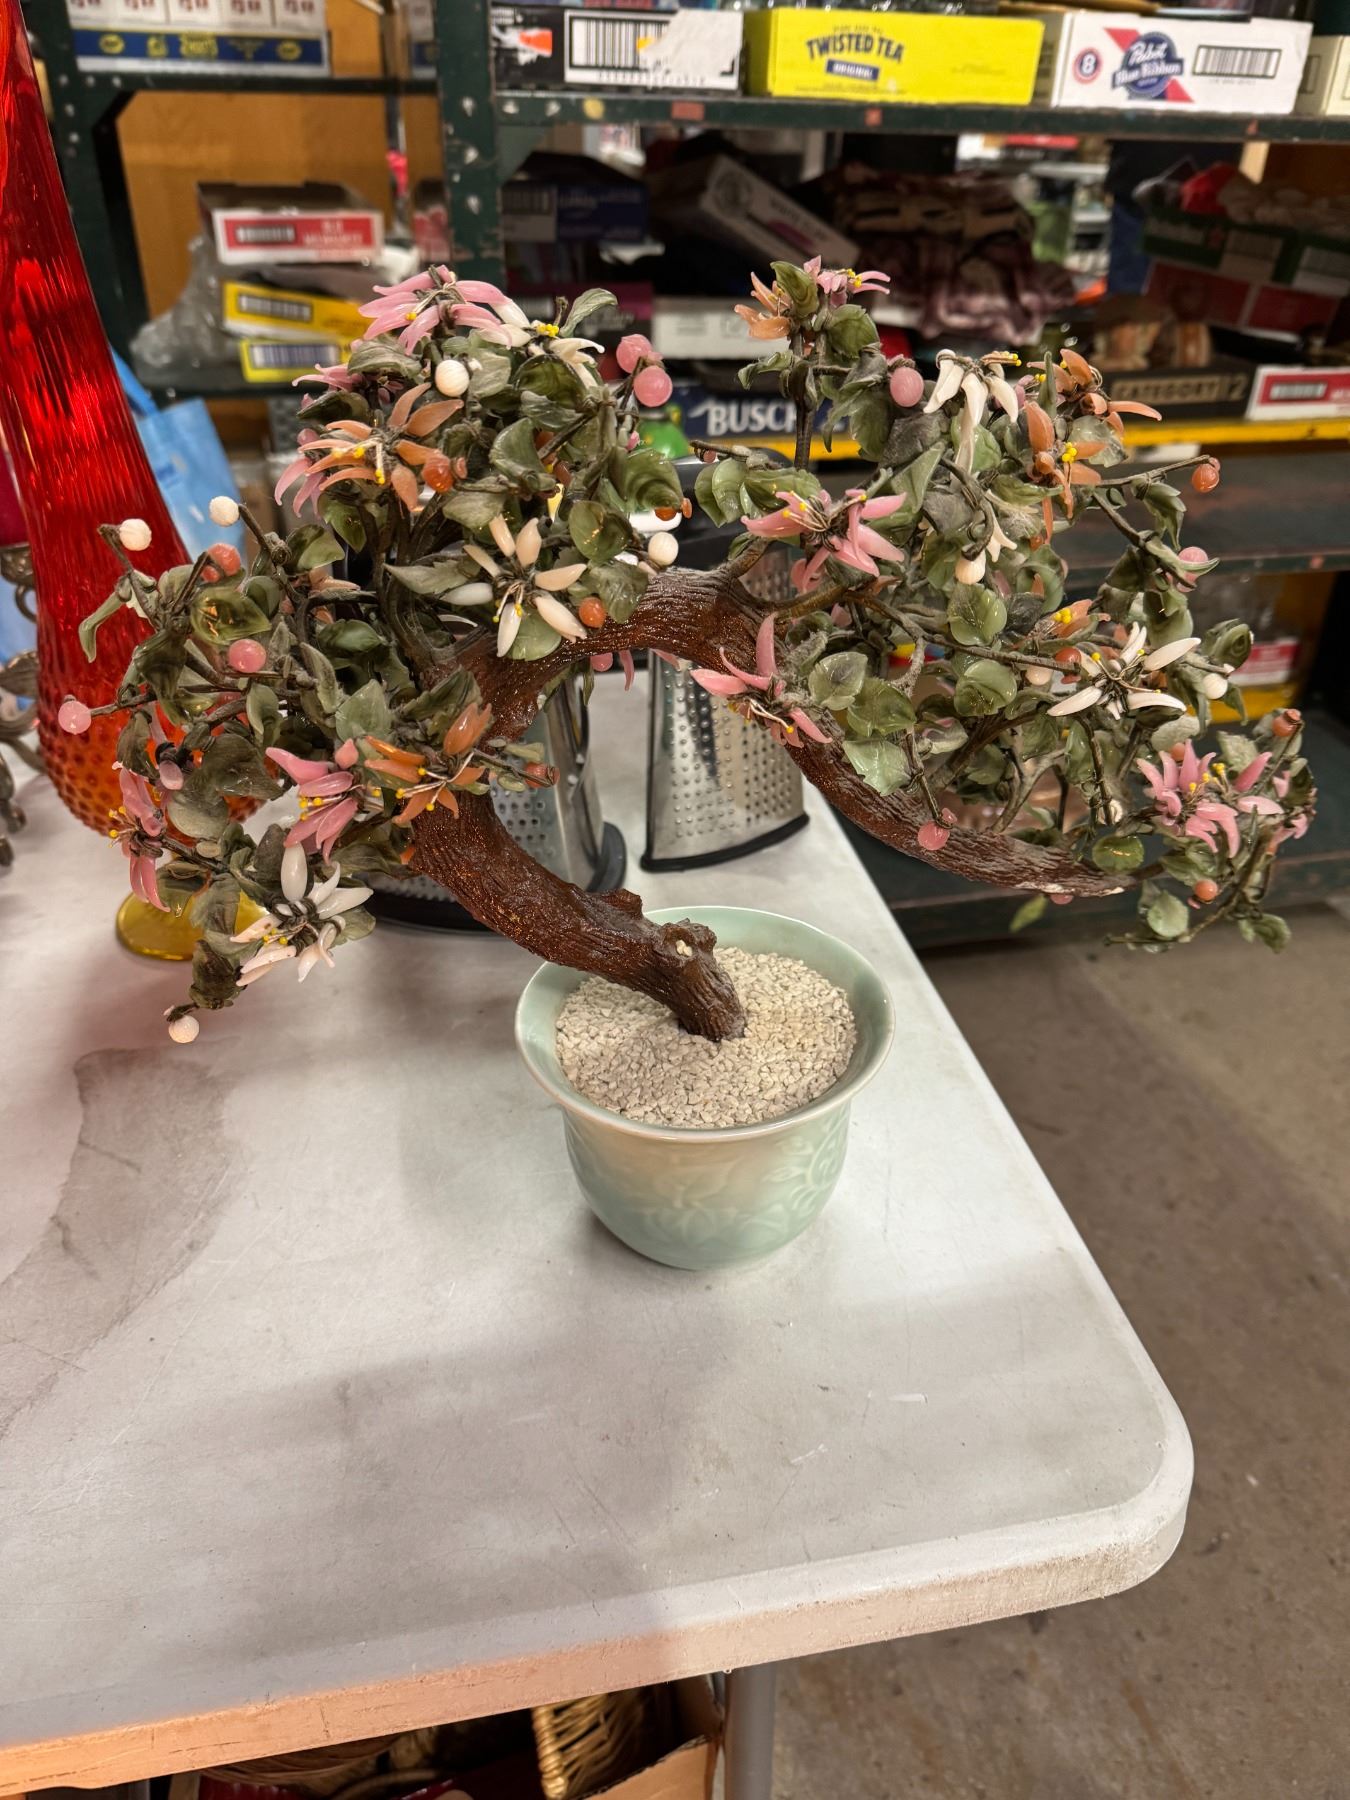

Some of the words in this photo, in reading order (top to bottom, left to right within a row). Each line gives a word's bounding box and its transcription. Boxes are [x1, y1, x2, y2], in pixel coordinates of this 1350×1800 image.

[806, 33, 874, 60] TWISTED
[877, 36, 905, 64] TEA
[1127, 41, 1168, 66] Pabst
[831, 62, 874, 79] ORIGINAL
[1081, 53, 1096, 75] 8
[1115, 70, 1140, 86] Blue
[1141, 60, 1181, 78] Ribbon
